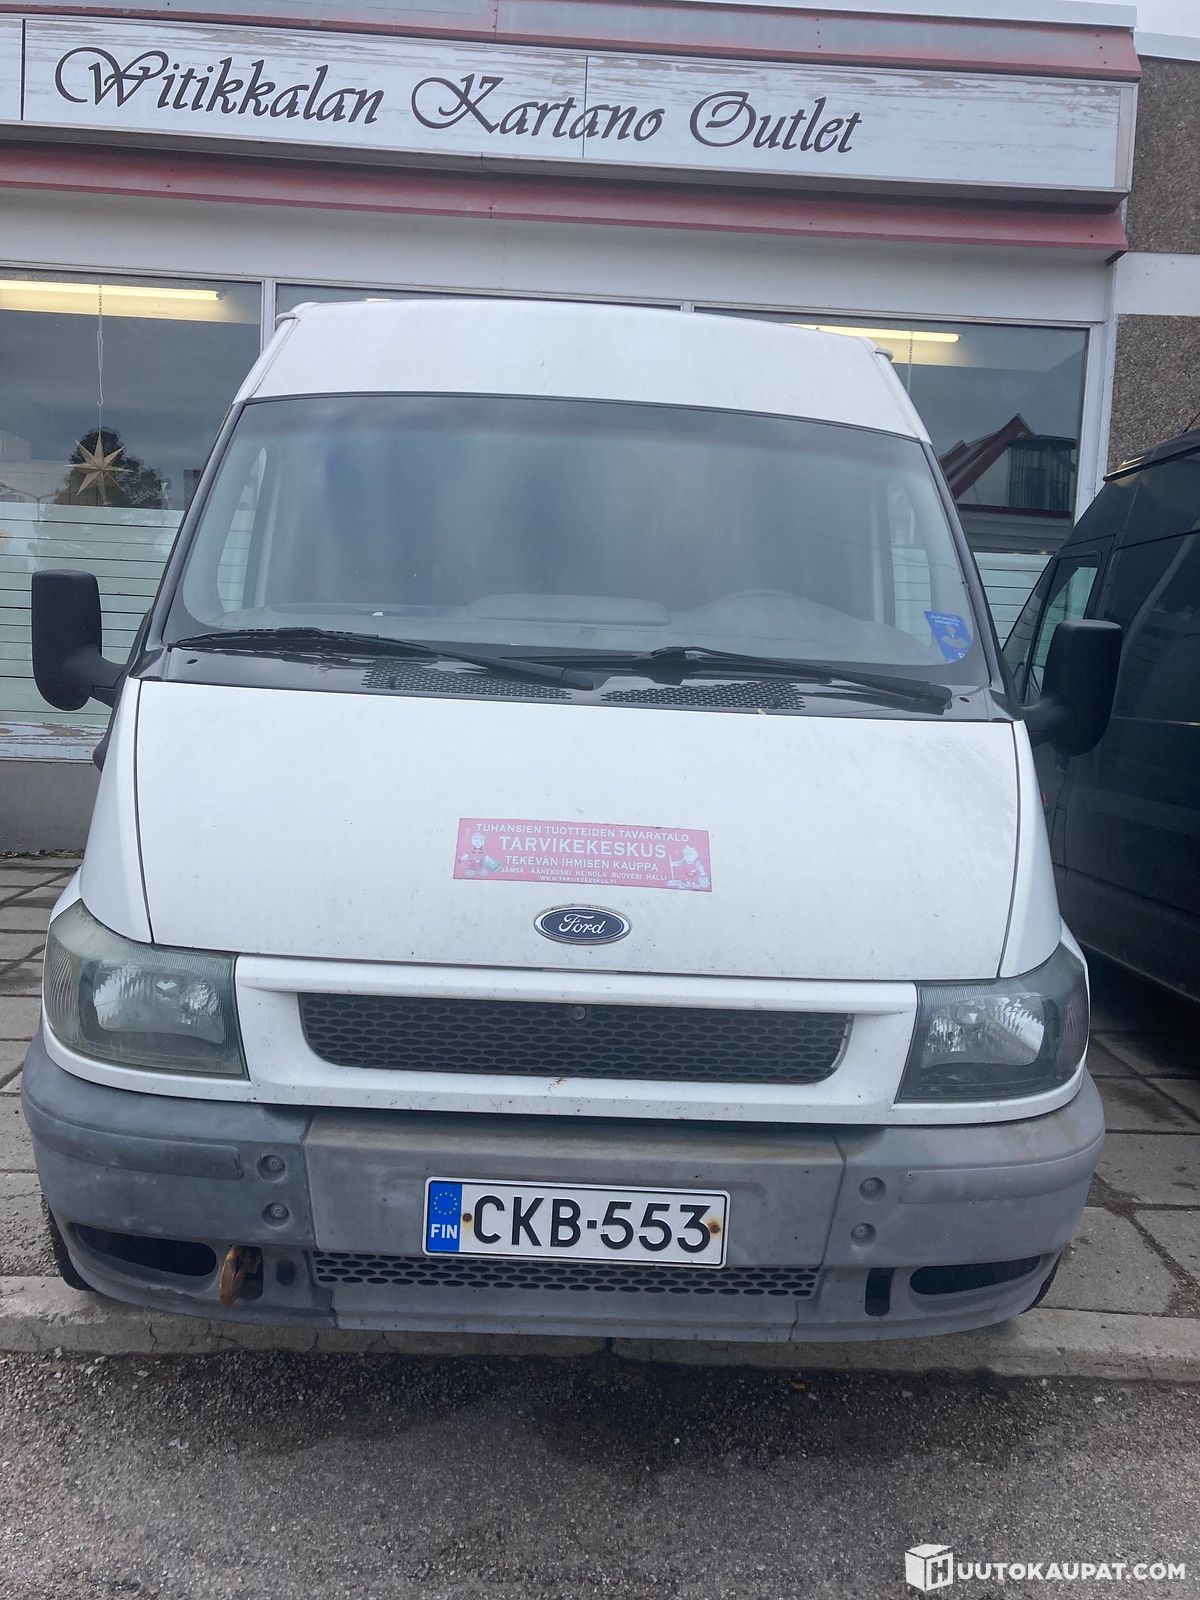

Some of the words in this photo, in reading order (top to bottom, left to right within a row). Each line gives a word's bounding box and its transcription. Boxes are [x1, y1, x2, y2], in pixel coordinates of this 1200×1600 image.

[54, 46, 385, 124] Witikkalan
[410, 73, 666, 142] Kartano
[689, 90, 862, 153] Outlet
[476, 823, 541, 833] TUHANSIEN
[545, 826, 615, 838] TUOTTEIDEN
[619, 829, 689, 842] TAVARATALO
[499, 836, 667, 858] TARVIKEKESKUS
[613, 861, 659, 872] KAUPPA
[558, 913, 607, 934] Ford
[430, 1223, 458, 1239] FIN
[473, 1194, 712, 1253] CKB-553
